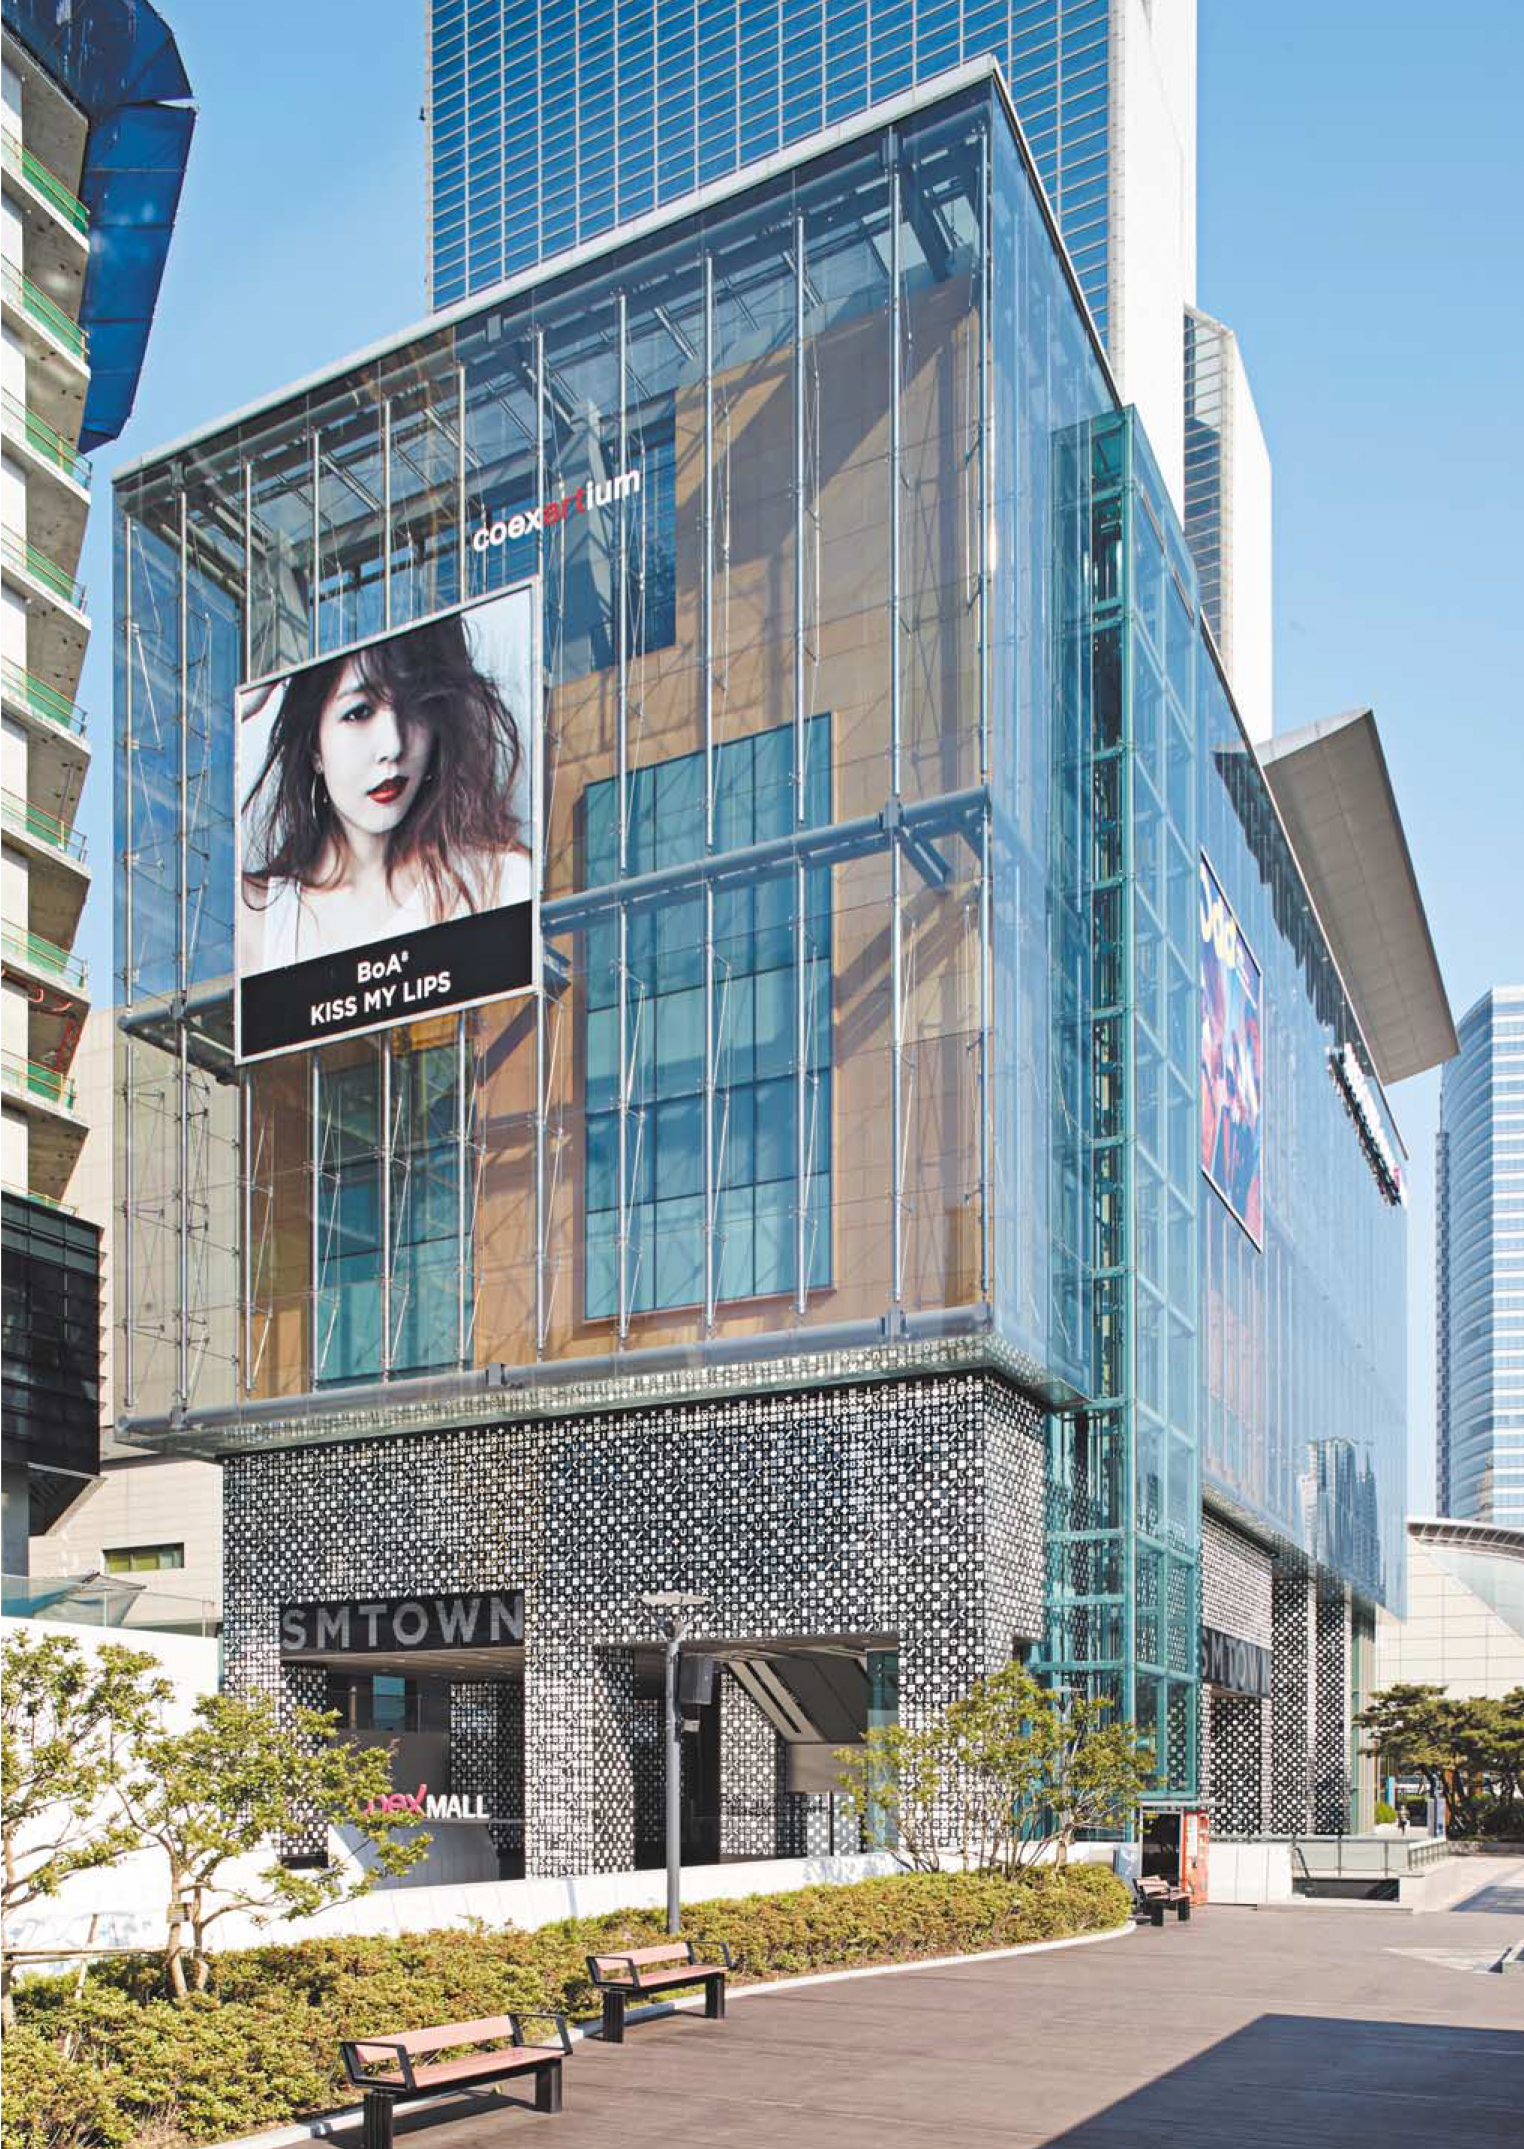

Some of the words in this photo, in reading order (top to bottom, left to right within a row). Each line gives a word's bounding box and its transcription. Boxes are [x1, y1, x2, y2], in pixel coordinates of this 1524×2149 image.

[473, 470, 640, 551] coexartium
[310, 996, 358, 1026] KISS
[364, 984, 397, 1013] MY
[403, 971, 451, 1003] LIPS
[281, 1595, 524, 1650] SMTOWN
[427, 1794, 490, 1819] MALL
